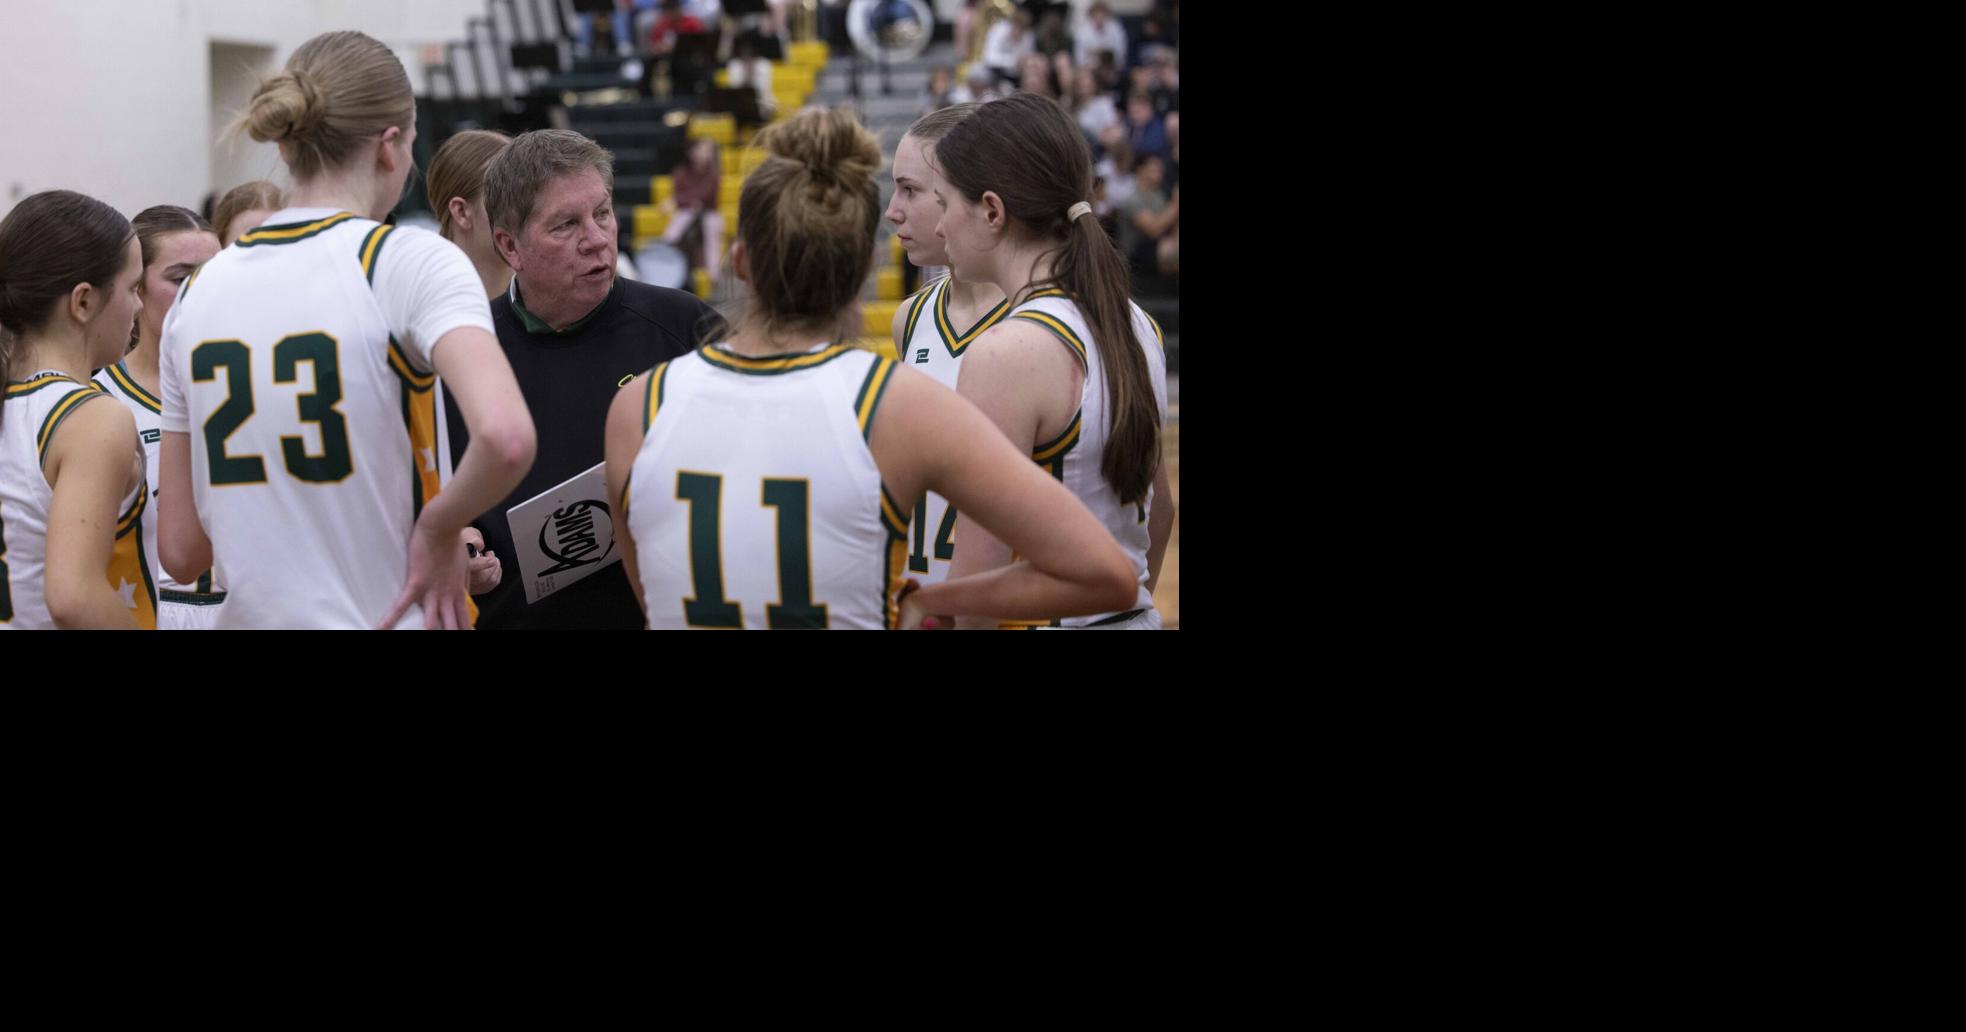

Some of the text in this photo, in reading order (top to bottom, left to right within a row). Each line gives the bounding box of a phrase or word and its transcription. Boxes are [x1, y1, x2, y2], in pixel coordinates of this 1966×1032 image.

[191, 330, 354, 487] 23
[537, 501, 602, 578] ADAMS
[675, 468, 829, 630] 11
